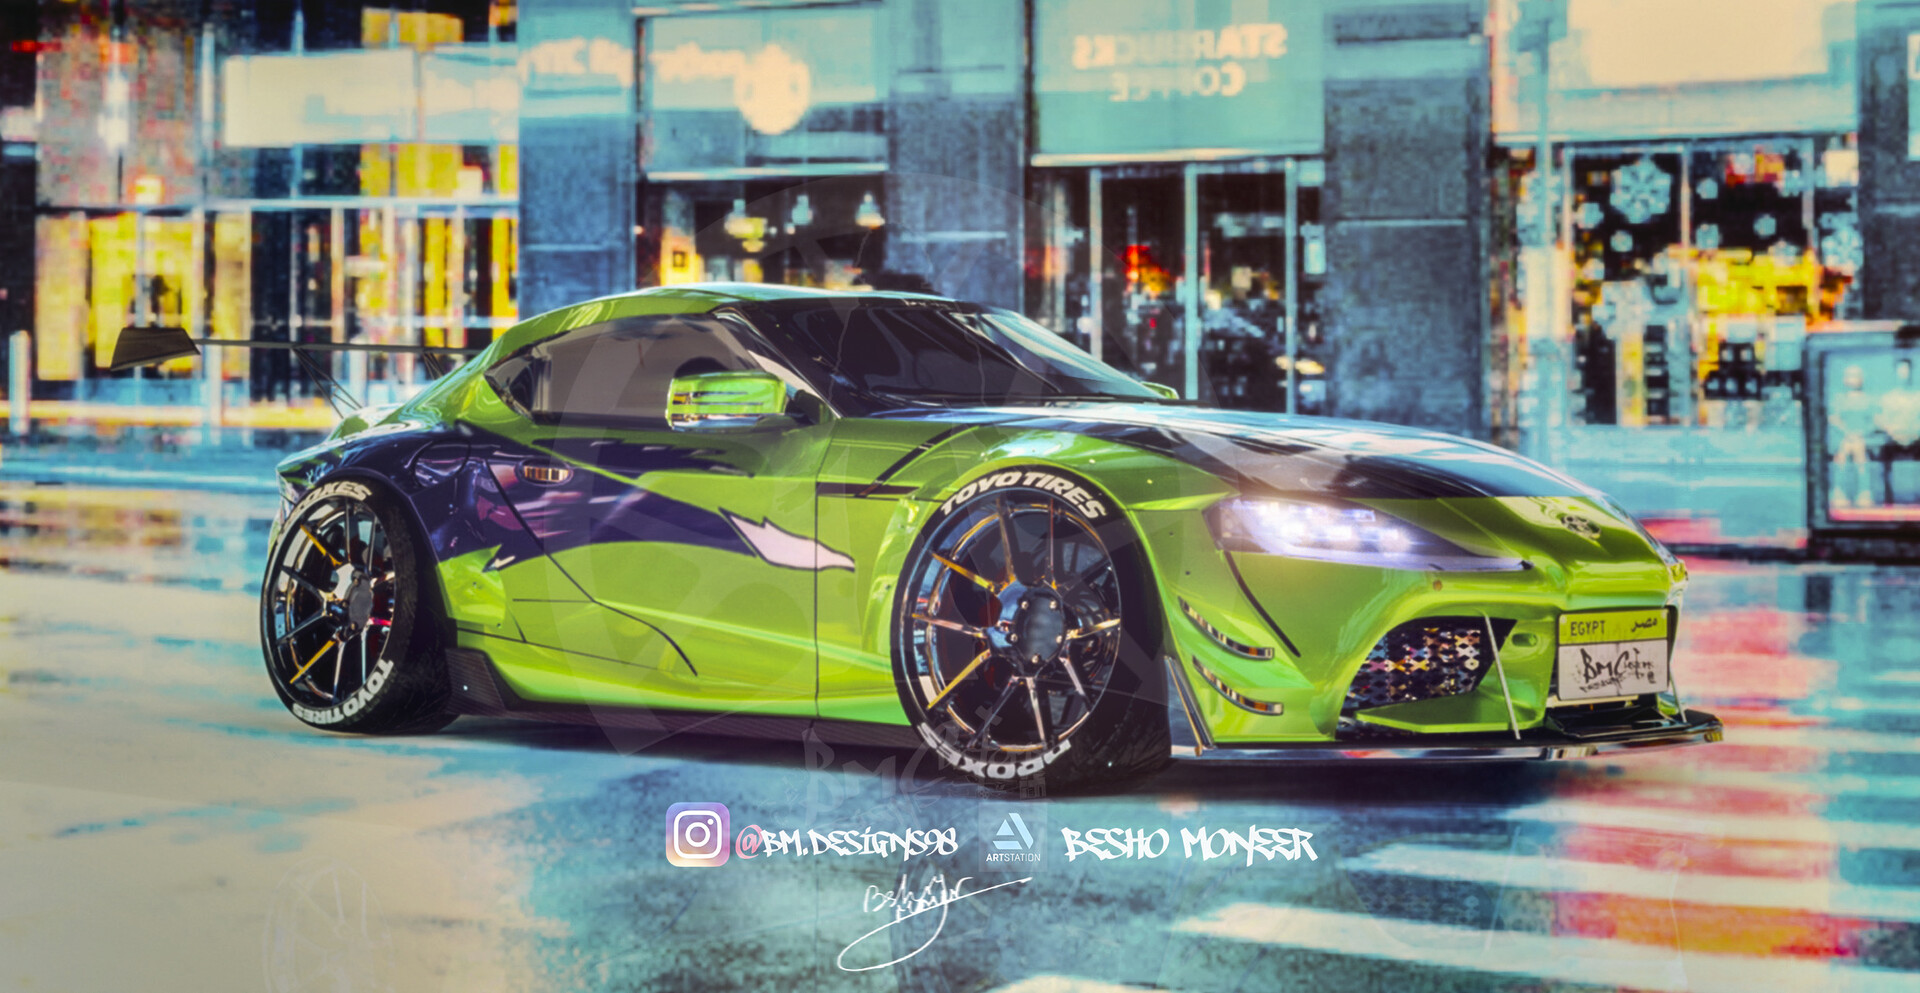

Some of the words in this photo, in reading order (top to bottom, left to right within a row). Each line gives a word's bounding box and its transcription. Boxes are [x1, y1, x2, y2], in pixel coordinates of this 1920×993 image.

[1020, 471, 1106, 520] TIRES
[1570, 620, 1605, 637] EGYPT
[1631, 617, 1658, 633] مصر
[292, 701, 345, 725] TIRES
